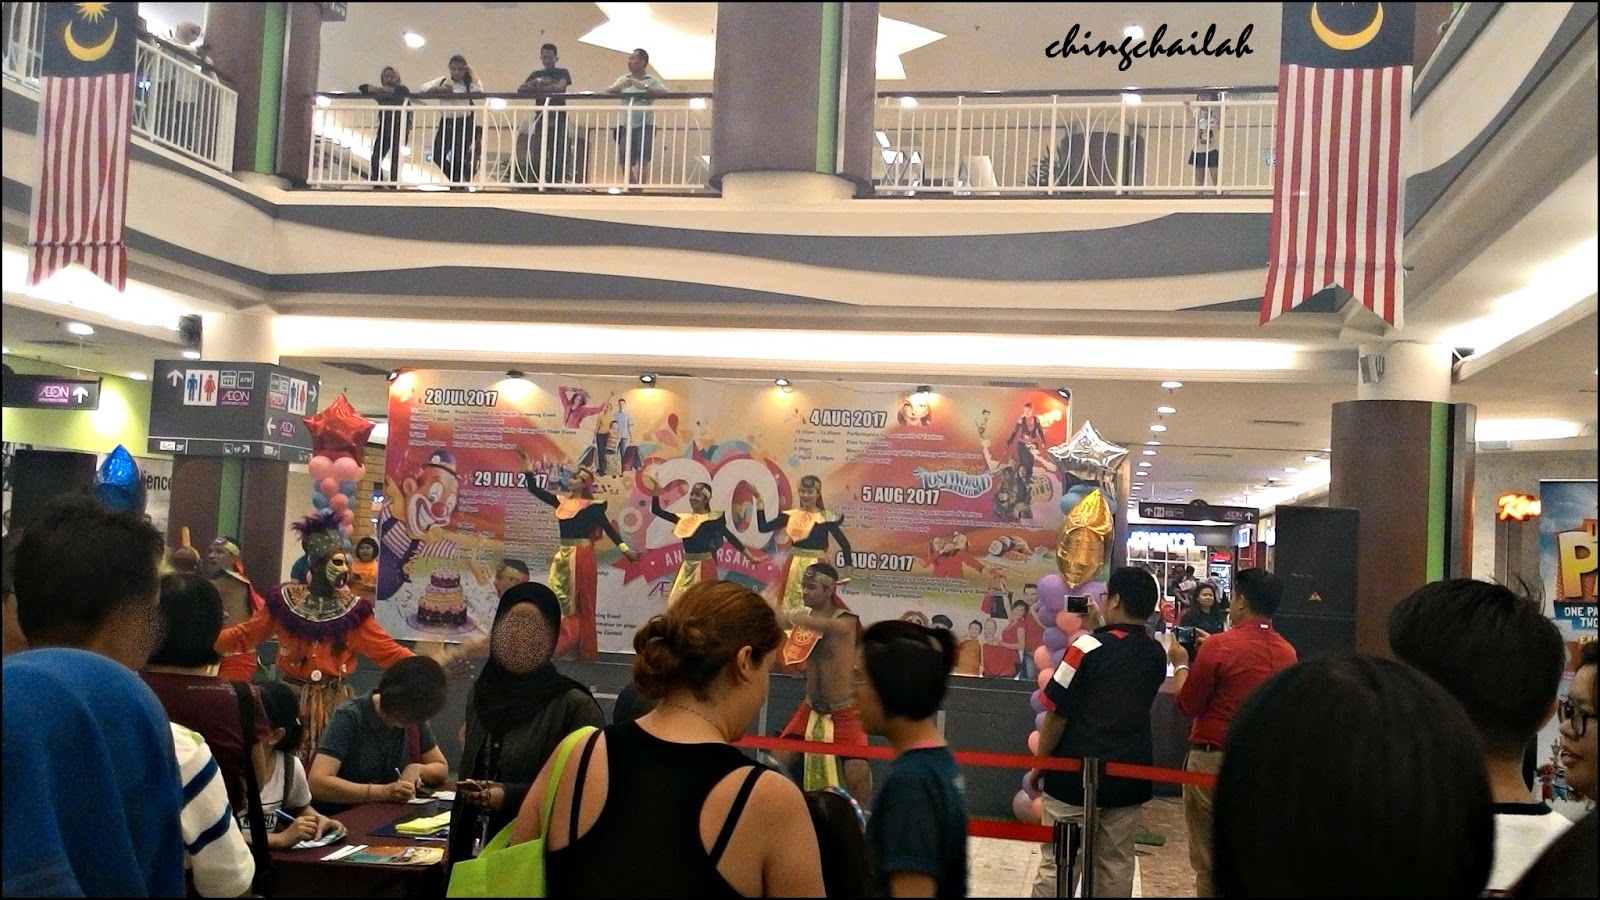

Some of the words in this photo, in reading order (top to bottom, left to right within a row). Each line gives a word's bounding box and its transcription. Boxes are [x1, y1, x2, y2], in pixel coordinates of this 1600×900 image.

[425, 388, 443, 405] 28
[444, 389, 466, 406] JUL
[467, 390, 499, 406] 2017
[810, 409, 821, 427] 4
[821, 409, 852, 427] AUG
[852, 410, 888, 428] 2017
[474, 471, 492, 488] 29
[492, 471, 515, 488] JUL
[517, 473, 548, 490] 217
[862, 486, 872, 503] 5
[873, 487, 904, 504] AUG
[906, 488, 940, 506] 2017
[835, 552, 846, 568] 6
[878, 555, 914, 572] 2017
[1564, 606, 1584, 617] ONE
